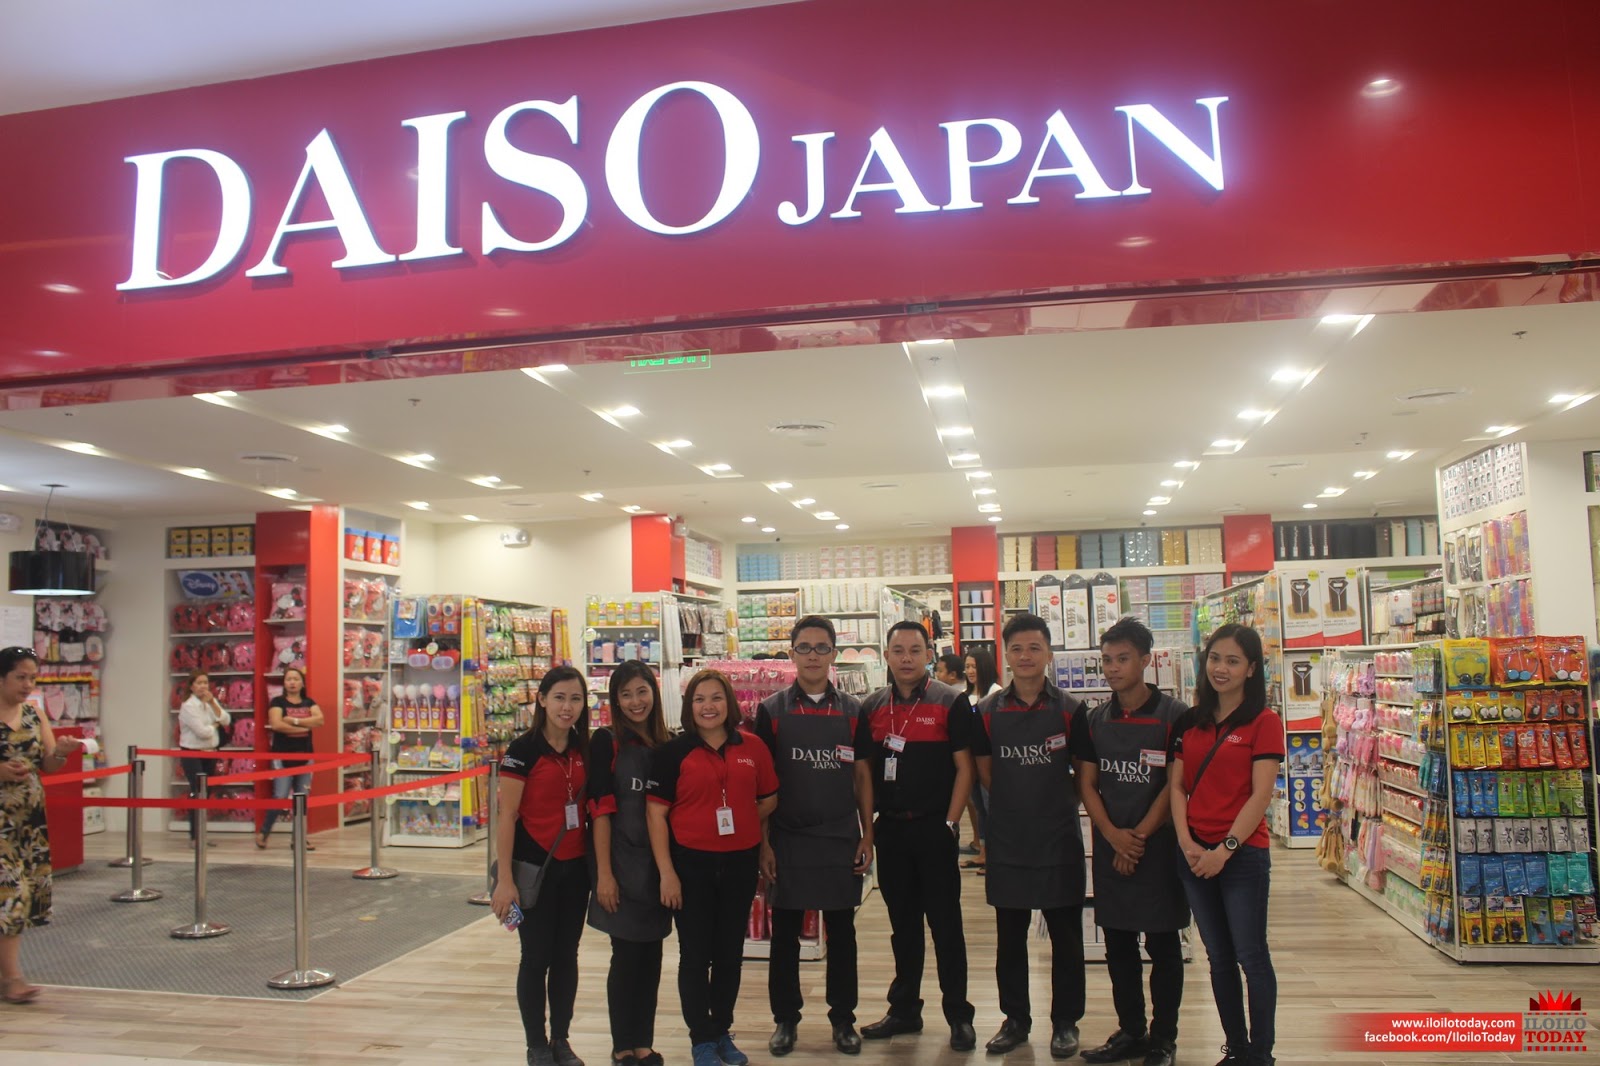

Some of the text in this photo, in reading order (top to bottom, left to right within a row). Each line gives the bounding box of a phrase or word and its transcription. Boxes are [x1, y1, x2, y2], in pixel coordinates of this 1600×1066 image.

[115, 80, 1230, 292] DAISO JAPAN
[185, 578, 216, 592] Disney
[812, 761, 841, 769] JAPAN
[1020, 756, 1052, 765] JAPAN
[1100, 758, 1151, 775] DAISO
[1117, 773, 1150, 784] JAPAN
